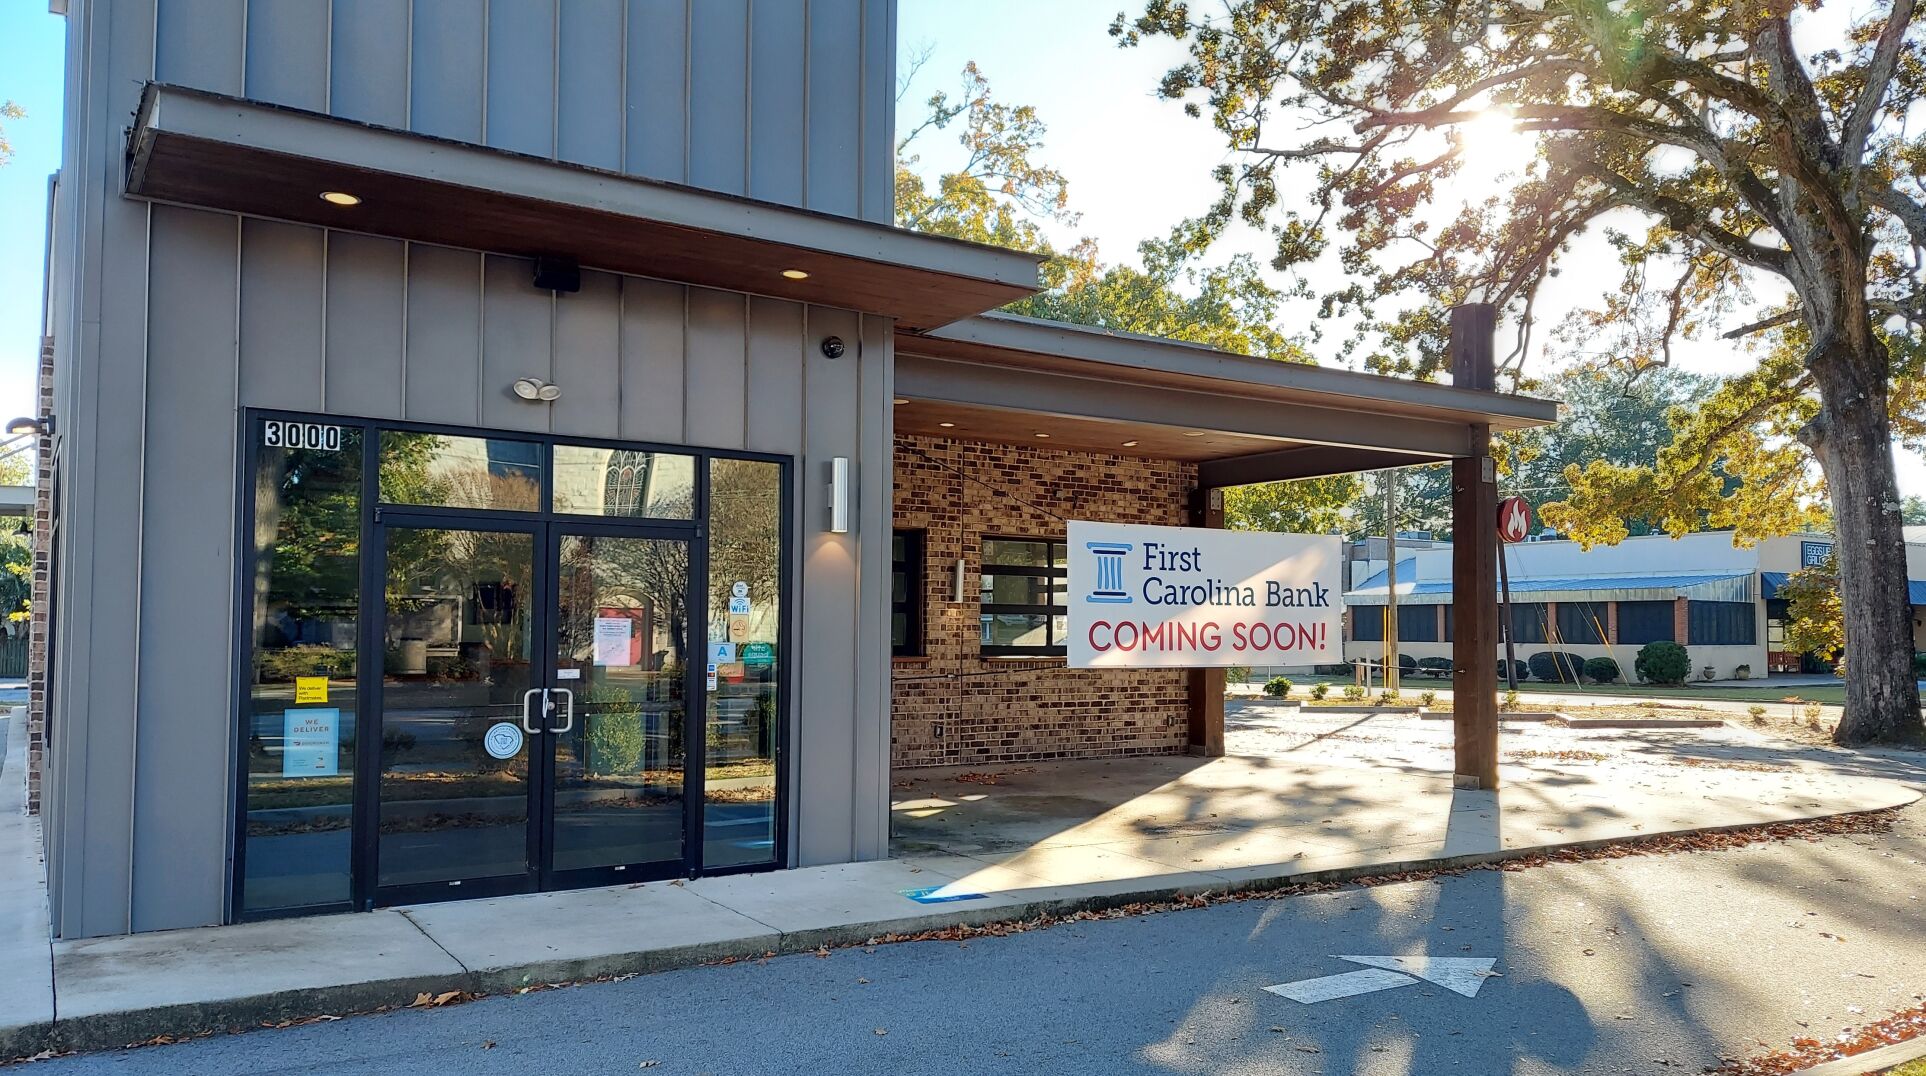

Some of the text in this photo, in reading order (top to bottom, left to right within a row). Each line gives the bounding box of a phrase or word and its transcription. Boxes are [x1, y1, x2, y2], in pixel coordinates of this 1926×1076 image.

[266, 421, 339, 450] 3000
[1142, 542, 1202, 572] First
[1142, 577, 1330, 608] Carolina Bank
[731, 604, 749, 613] WiFi
[1088, 620, 1326, 652] COMING SOON!
[717, 646, 728, 657] A
